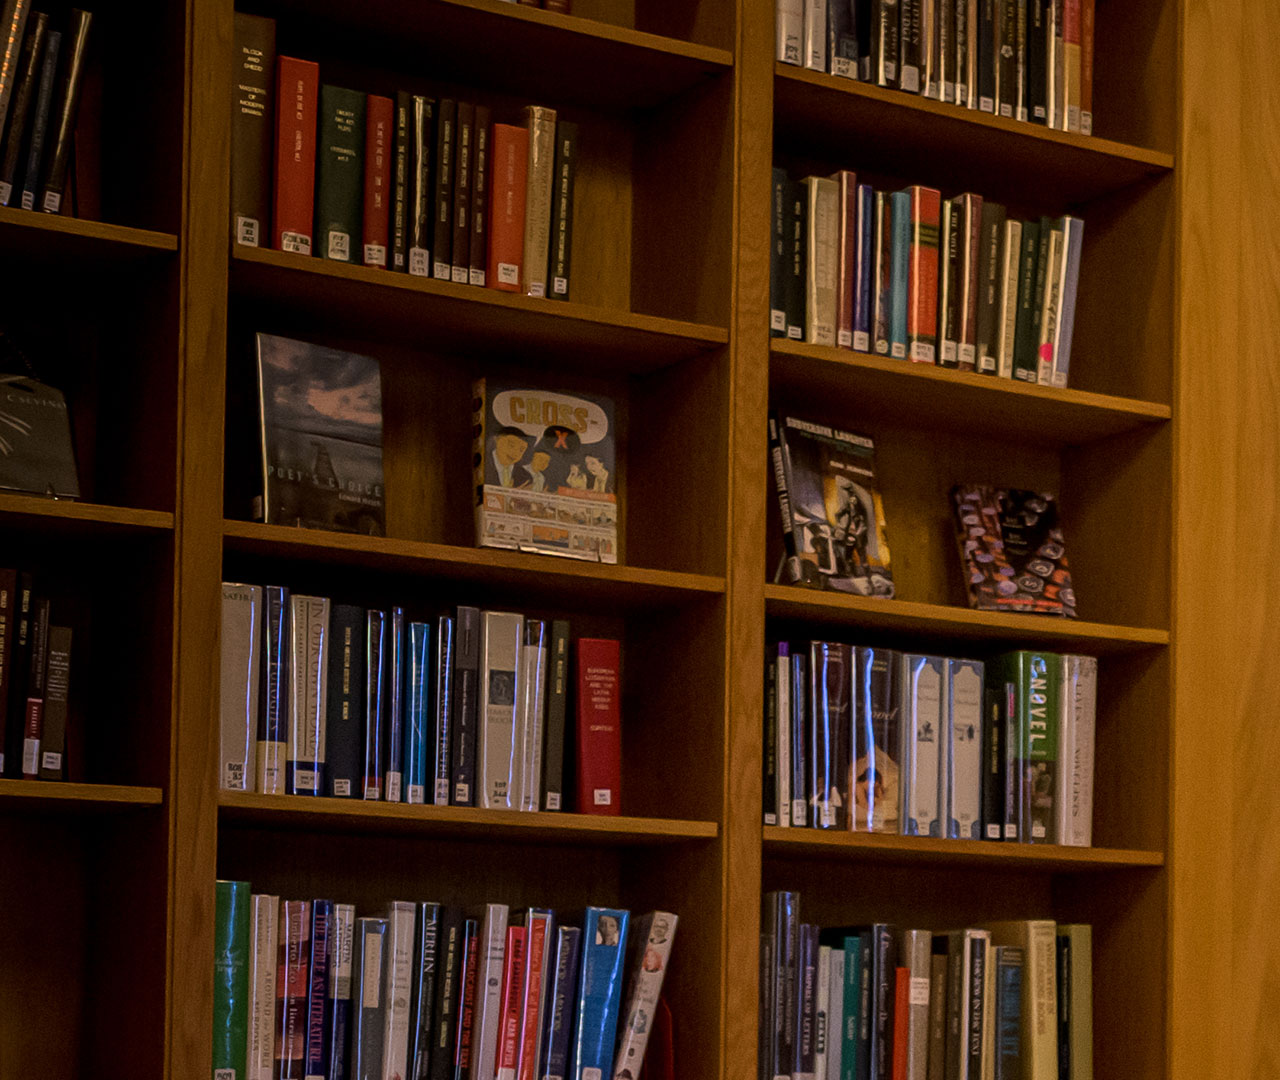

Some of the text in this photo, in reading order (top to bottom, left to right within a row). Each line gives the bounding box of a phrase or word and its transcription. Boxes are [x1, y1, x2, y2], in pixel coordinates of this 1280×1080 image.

[554, 430, 568, 449] X
[312, 602, 324, 618] IN
[290, 913, 303, 961] Umberto
[343, 924, 352, 964] MARTIN
[424, 919, 436, 973] MERLIN
[263, 971, 272, 1016] AROUND
[289, 964, 301, 983] Eco
[309, 992, 323, 1063] LITERATURE
